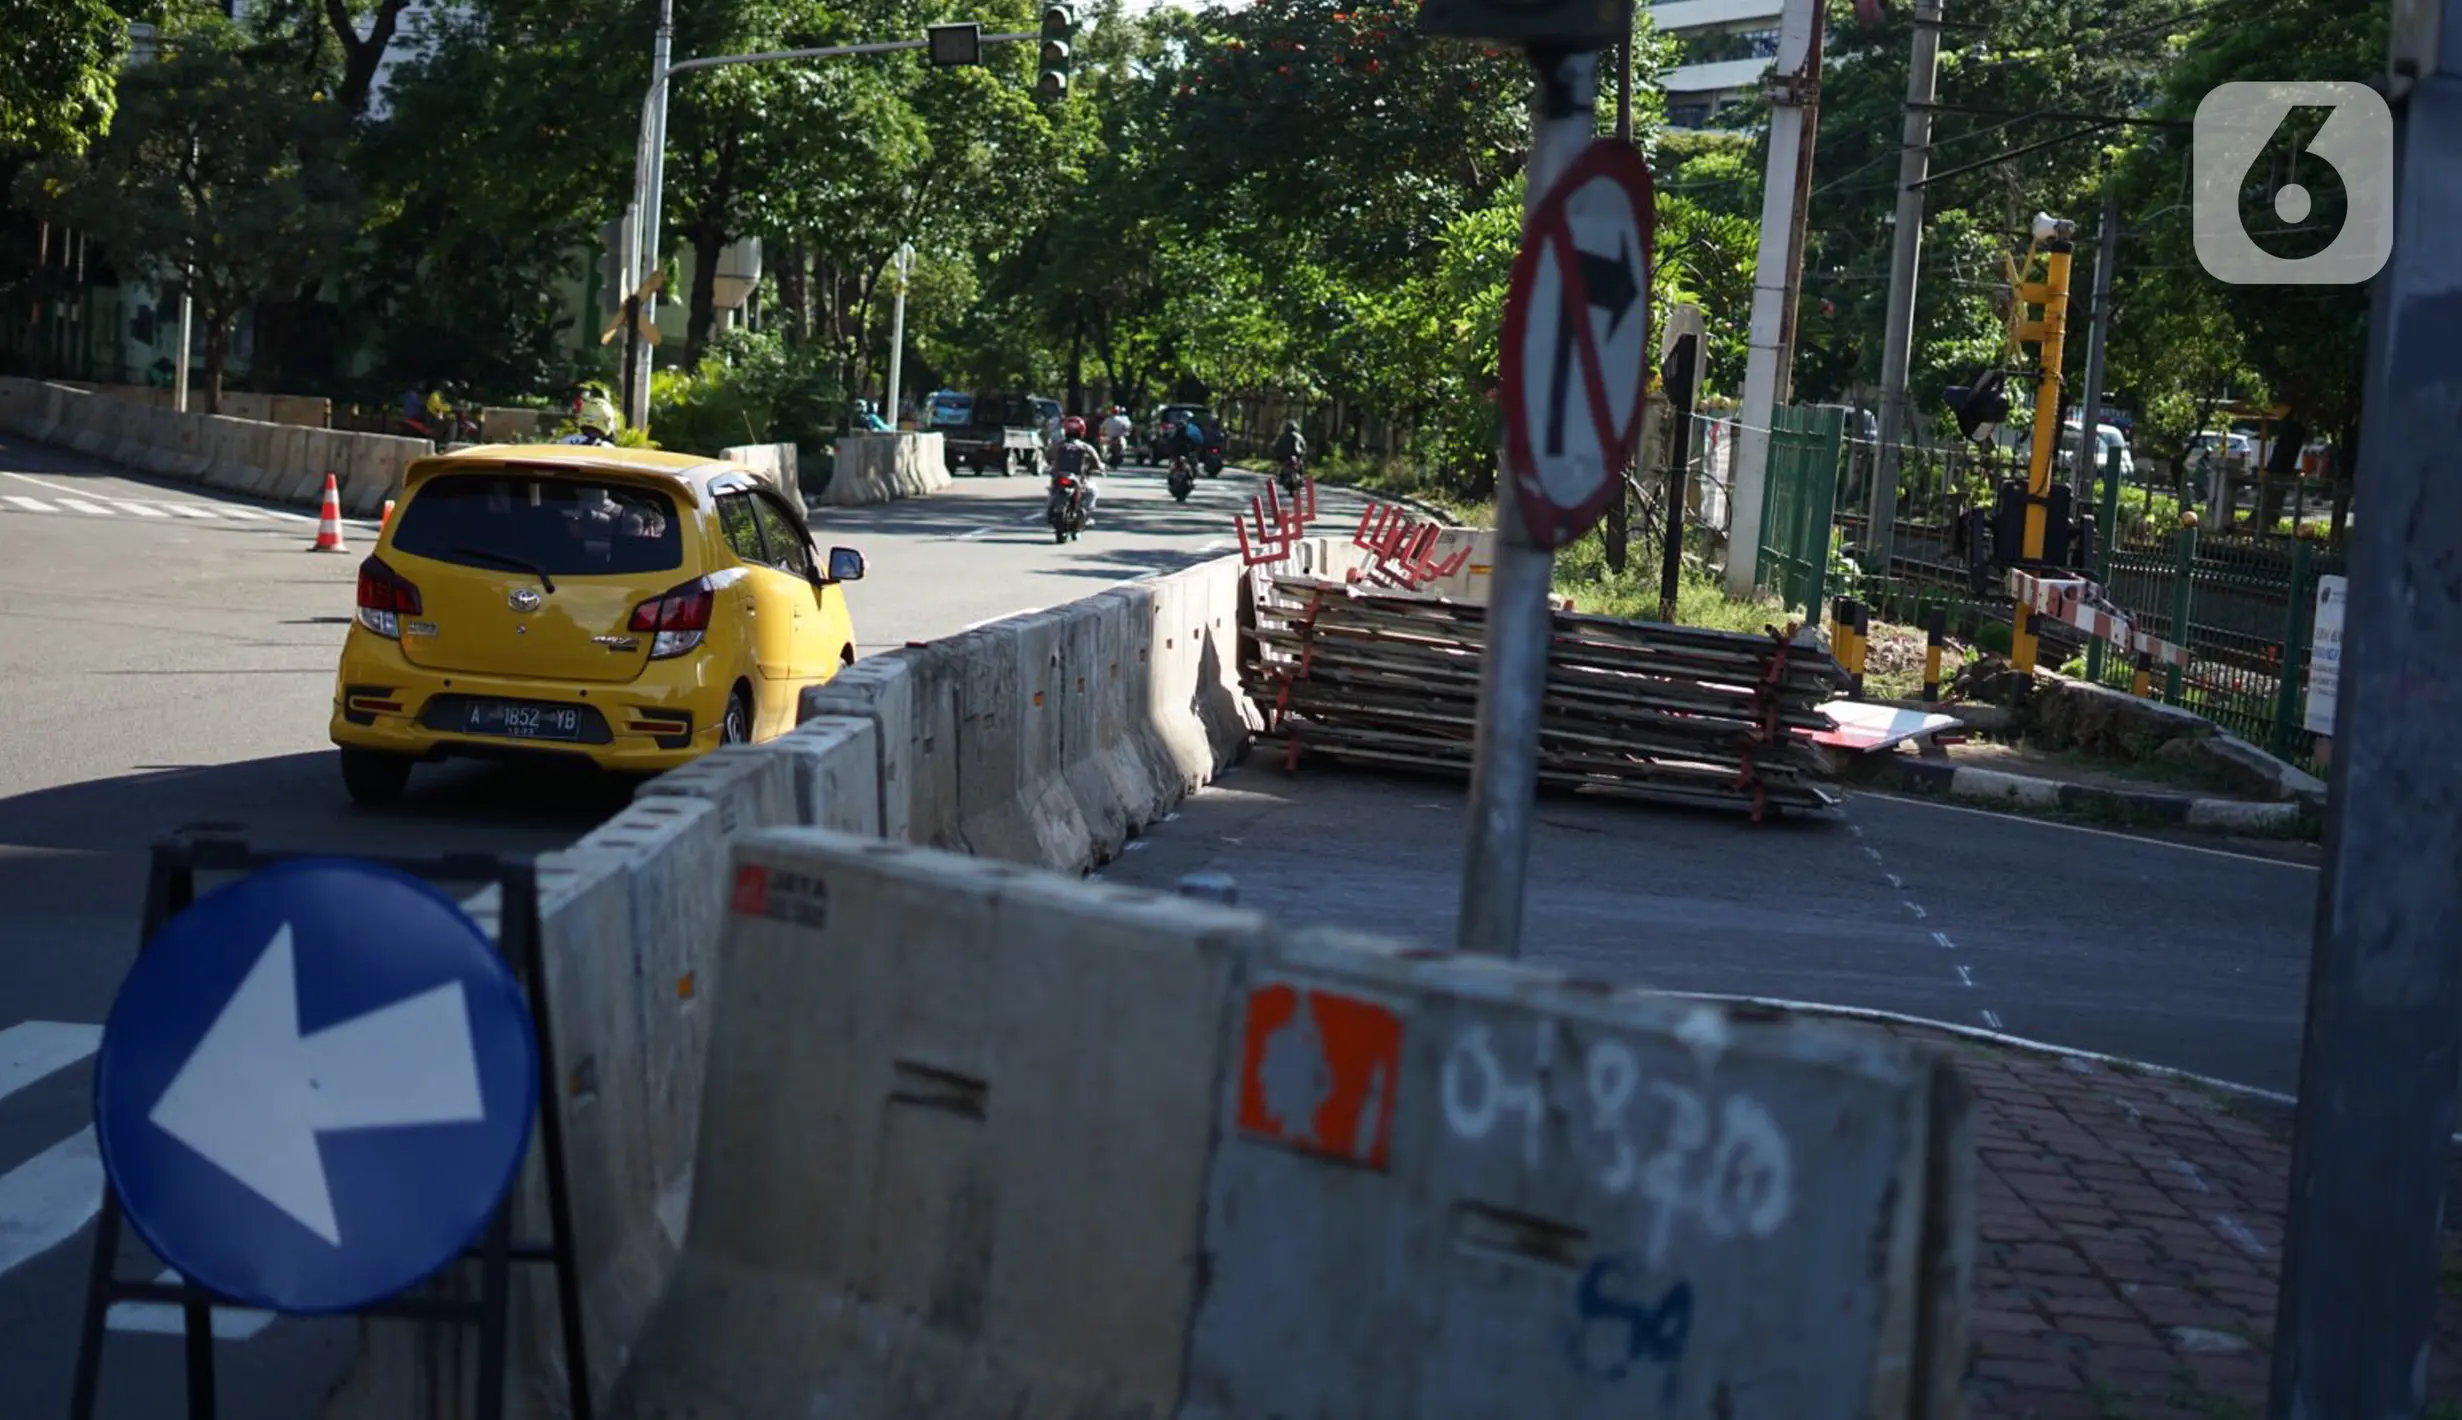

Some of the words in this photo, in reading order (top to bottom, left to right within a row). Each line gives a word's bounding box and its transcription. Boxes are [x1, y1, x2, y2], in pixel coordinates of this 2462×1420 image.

[470, 704, 480, 724] A
[503, 706, 540, 728] 1852
[556, 709, 577, 730] YB
